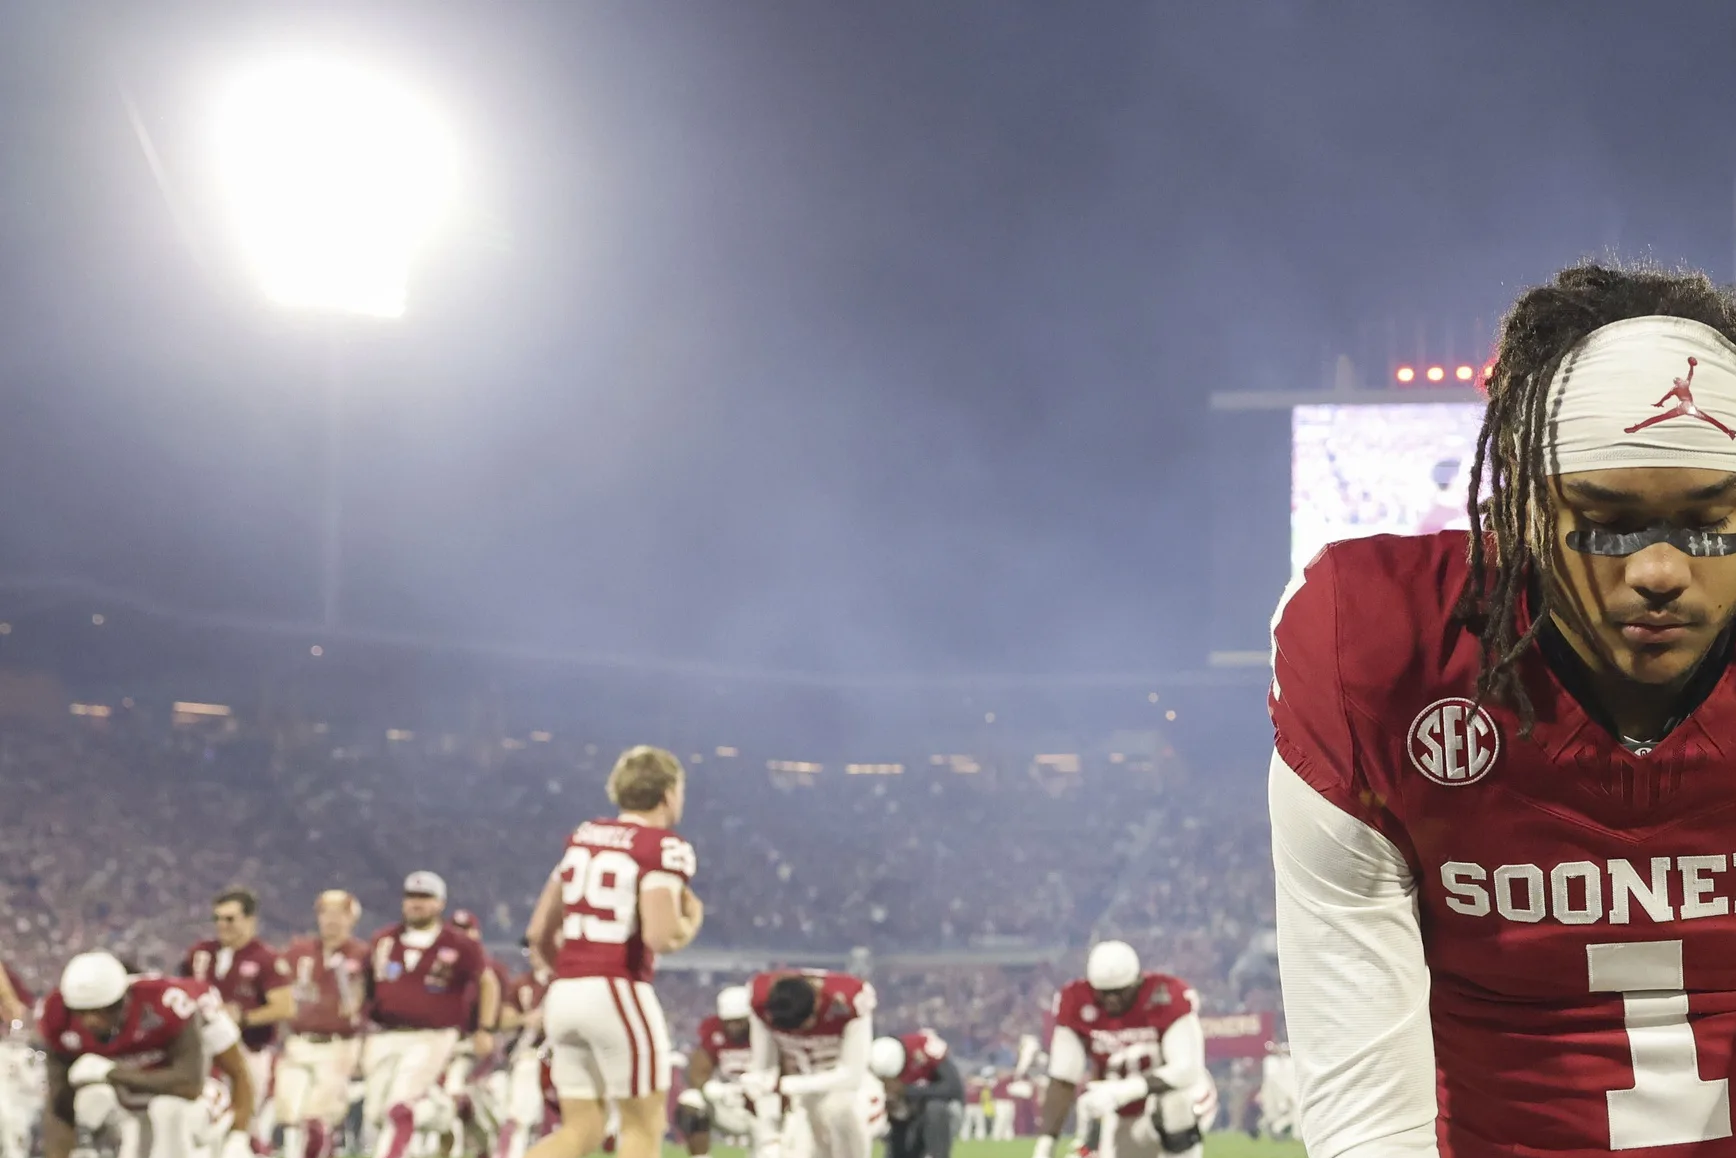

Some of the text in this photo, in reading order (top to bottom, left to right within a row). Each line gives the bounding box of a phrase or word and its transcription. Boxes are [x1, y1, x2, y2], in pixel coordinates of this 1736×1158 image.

[1416, 705, 1491, 779] SEC
[559, 845, 640, 944] 29
[1586, 939, 1733, 1151] 1
